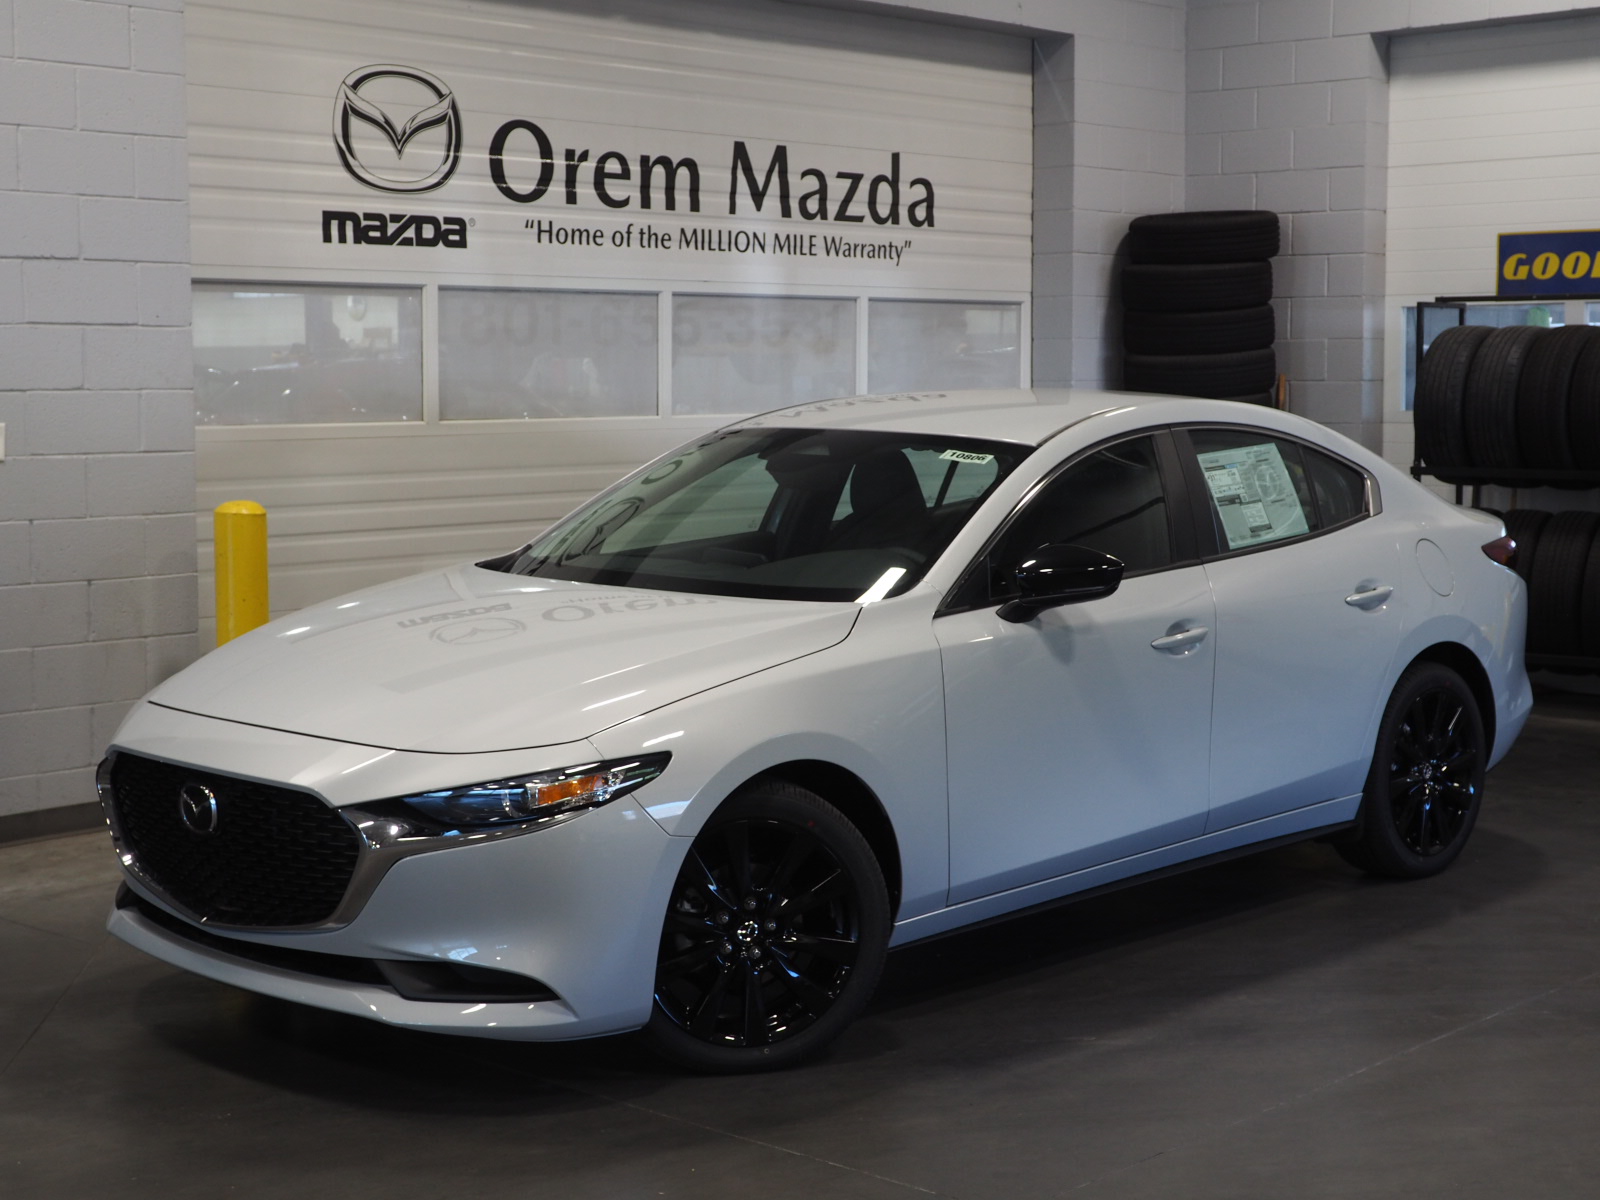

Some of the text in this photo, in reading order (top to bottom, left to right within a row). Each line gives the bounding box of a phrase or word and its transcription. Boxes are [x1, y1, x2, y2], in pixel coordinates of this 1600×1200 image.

[488, 118, 935, 228] Orem Mazda
[611, 223, 634, 248] of
[639, 225, 672, 249] the
[678, 227, 766, 254] MILLION
[773, 232, 818, 257] MILE
[949, 451, 988, 461] 10806
